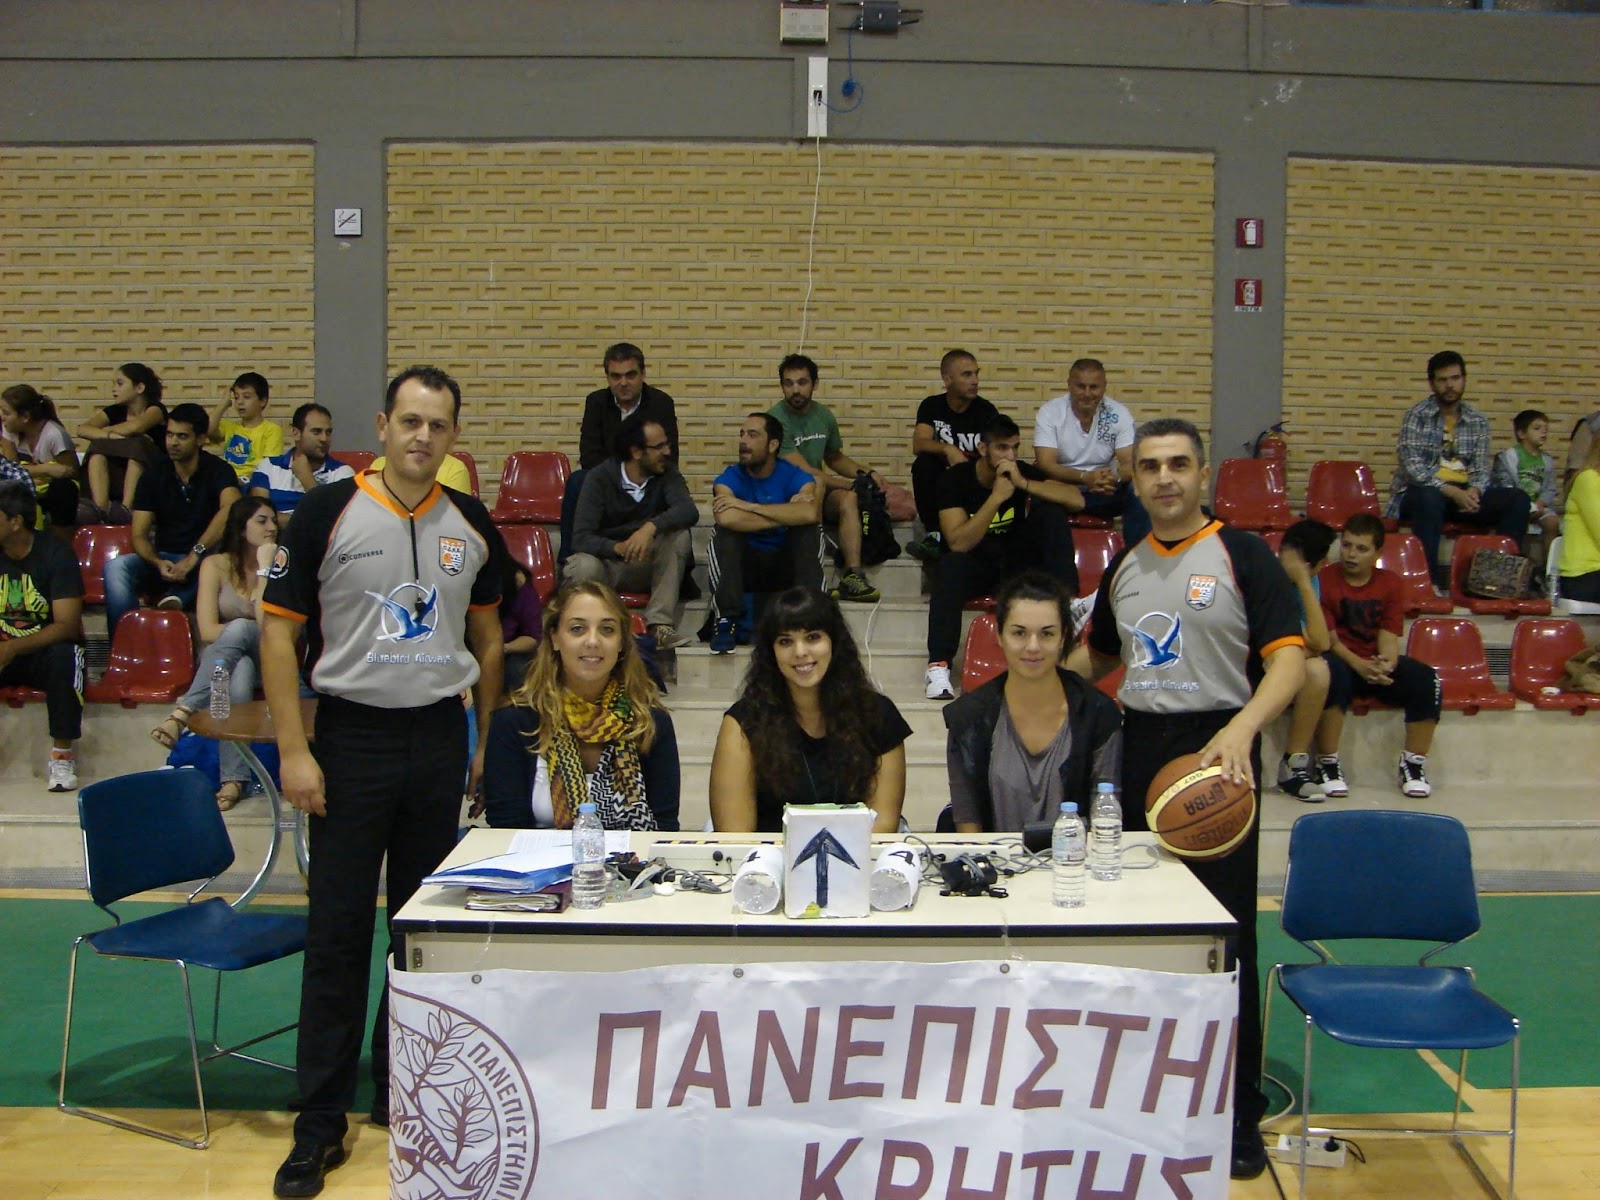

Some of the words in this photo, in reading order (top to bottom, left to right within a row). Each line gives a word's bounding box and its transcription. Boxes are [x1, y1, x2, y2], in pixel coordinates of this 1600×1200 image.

[366, 651, 410, 664] Bluebird
[414, 652, 452, 666] Airways
[1183, 791, 1217, 815] FIBA
[467, 1041, 527, 1200] ΠΑΝΕΠΙΣΤΗΜΙ
